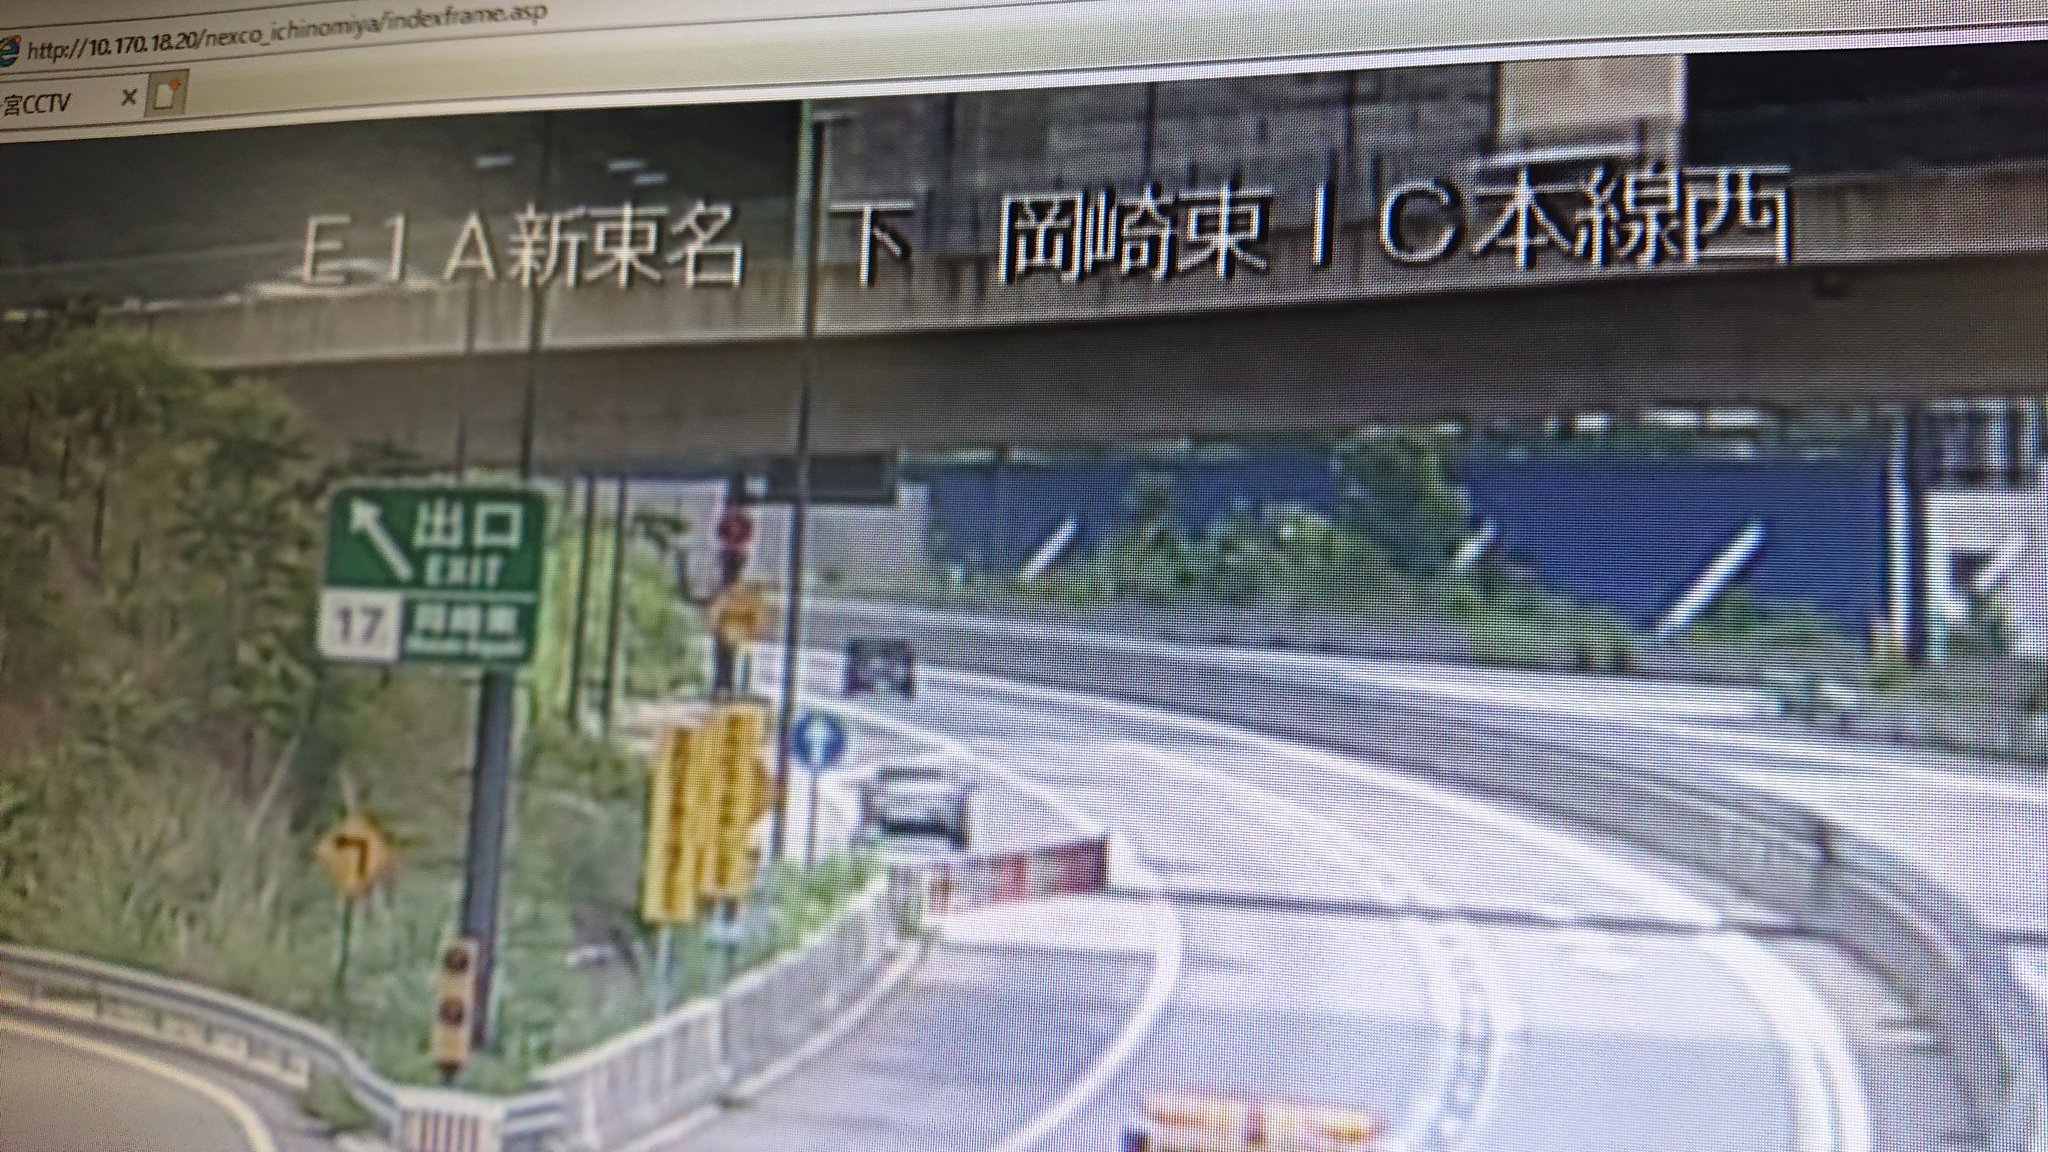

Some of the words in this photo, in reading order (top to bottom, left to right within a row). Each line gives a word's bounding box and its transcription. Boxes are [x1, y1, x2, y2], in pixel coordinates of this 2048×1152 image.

[0, 92, 72, 117] 宮CCTV
[829, 200, 914, 287] 下
[414, 498, 523, 547] 出口
[424, 553, 503, 587] EXIT
[336, 606, 386, 646] 17
